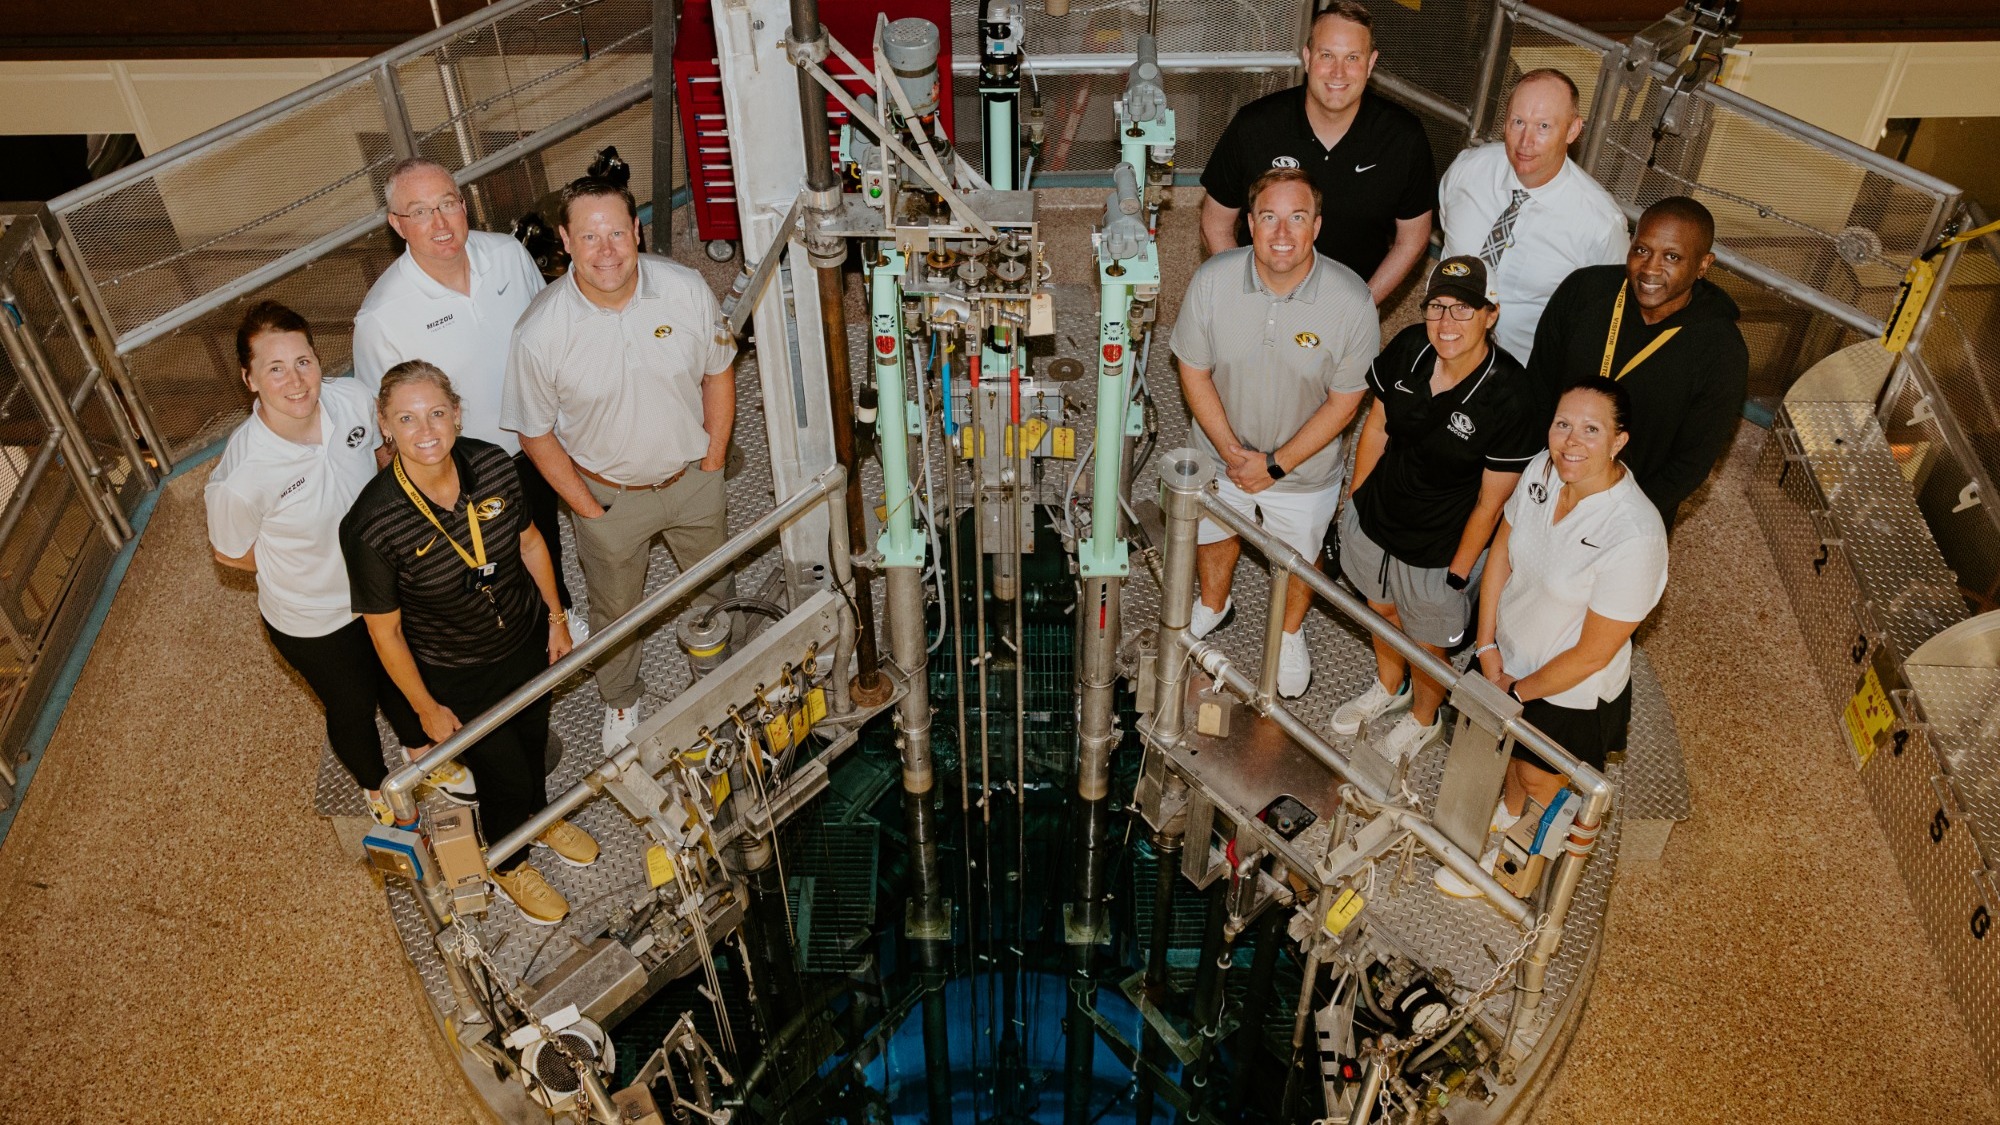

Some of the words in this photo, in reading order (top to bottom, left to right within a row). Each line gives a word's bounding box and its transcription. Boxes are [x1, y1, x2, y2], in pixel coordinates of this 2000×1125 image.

[426, 314, 454, 330] MIZZOU
[1608, 317, 1620, 346] VISITOR
[1601, 354, 1611, 377] VISITO
[1446, 424, 1469, 440] SOCCER
[280, 477, 305, 499] MIZZOU
[410, 491, 431, 516] VISITOR
[1813, 543, 1829, 577] 2
[1852, 634, 1867, 664] 3
[1868, 674, 1890, 718] CAUTION
[1892, 728, 1909, 758] 4
[1929, 807, 1950, 843] 5
